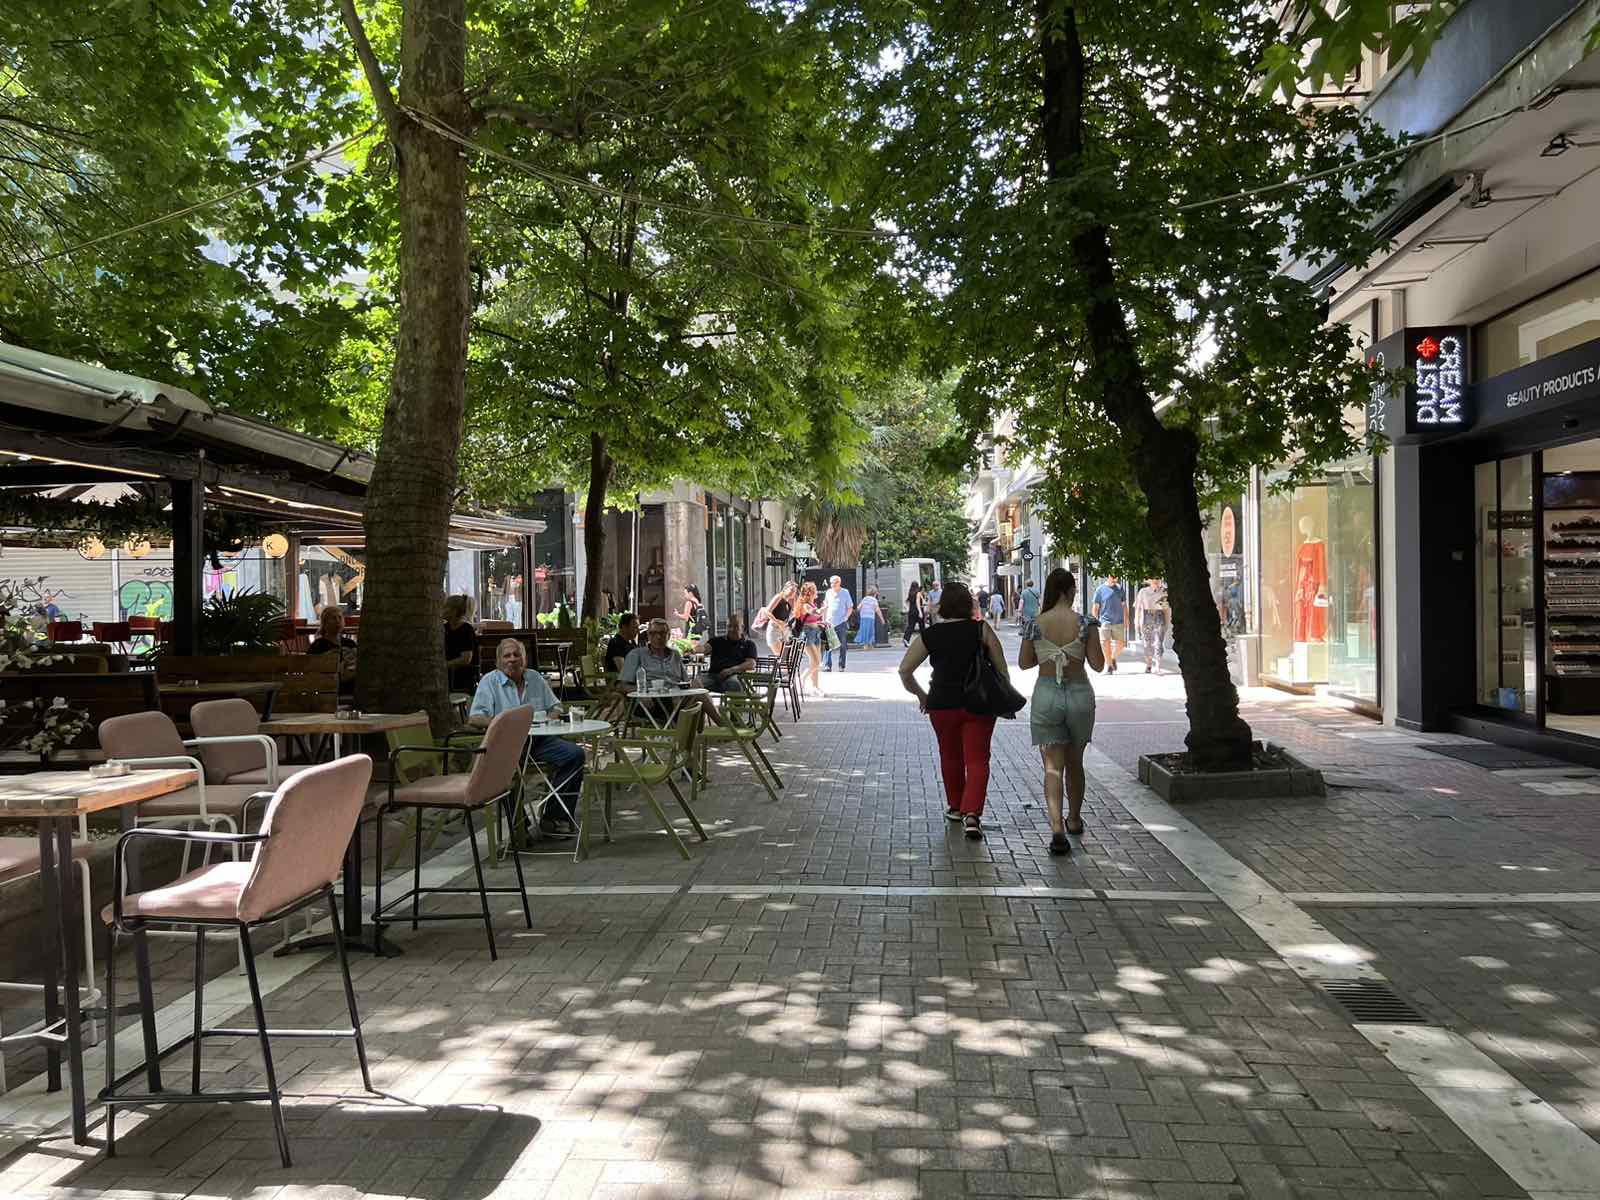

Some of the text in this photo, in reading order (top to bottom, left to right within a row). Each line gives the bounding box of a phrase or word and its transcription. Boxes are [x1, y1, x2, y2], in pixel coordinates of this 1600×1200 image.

[1416, 358, 1438, 423] DUST
[1440, 336, 1461, 422] CREAM
[1506, 384, 1541, 408] BEAUTY
[1543, 367, 1594, 396] PRODUCTS
